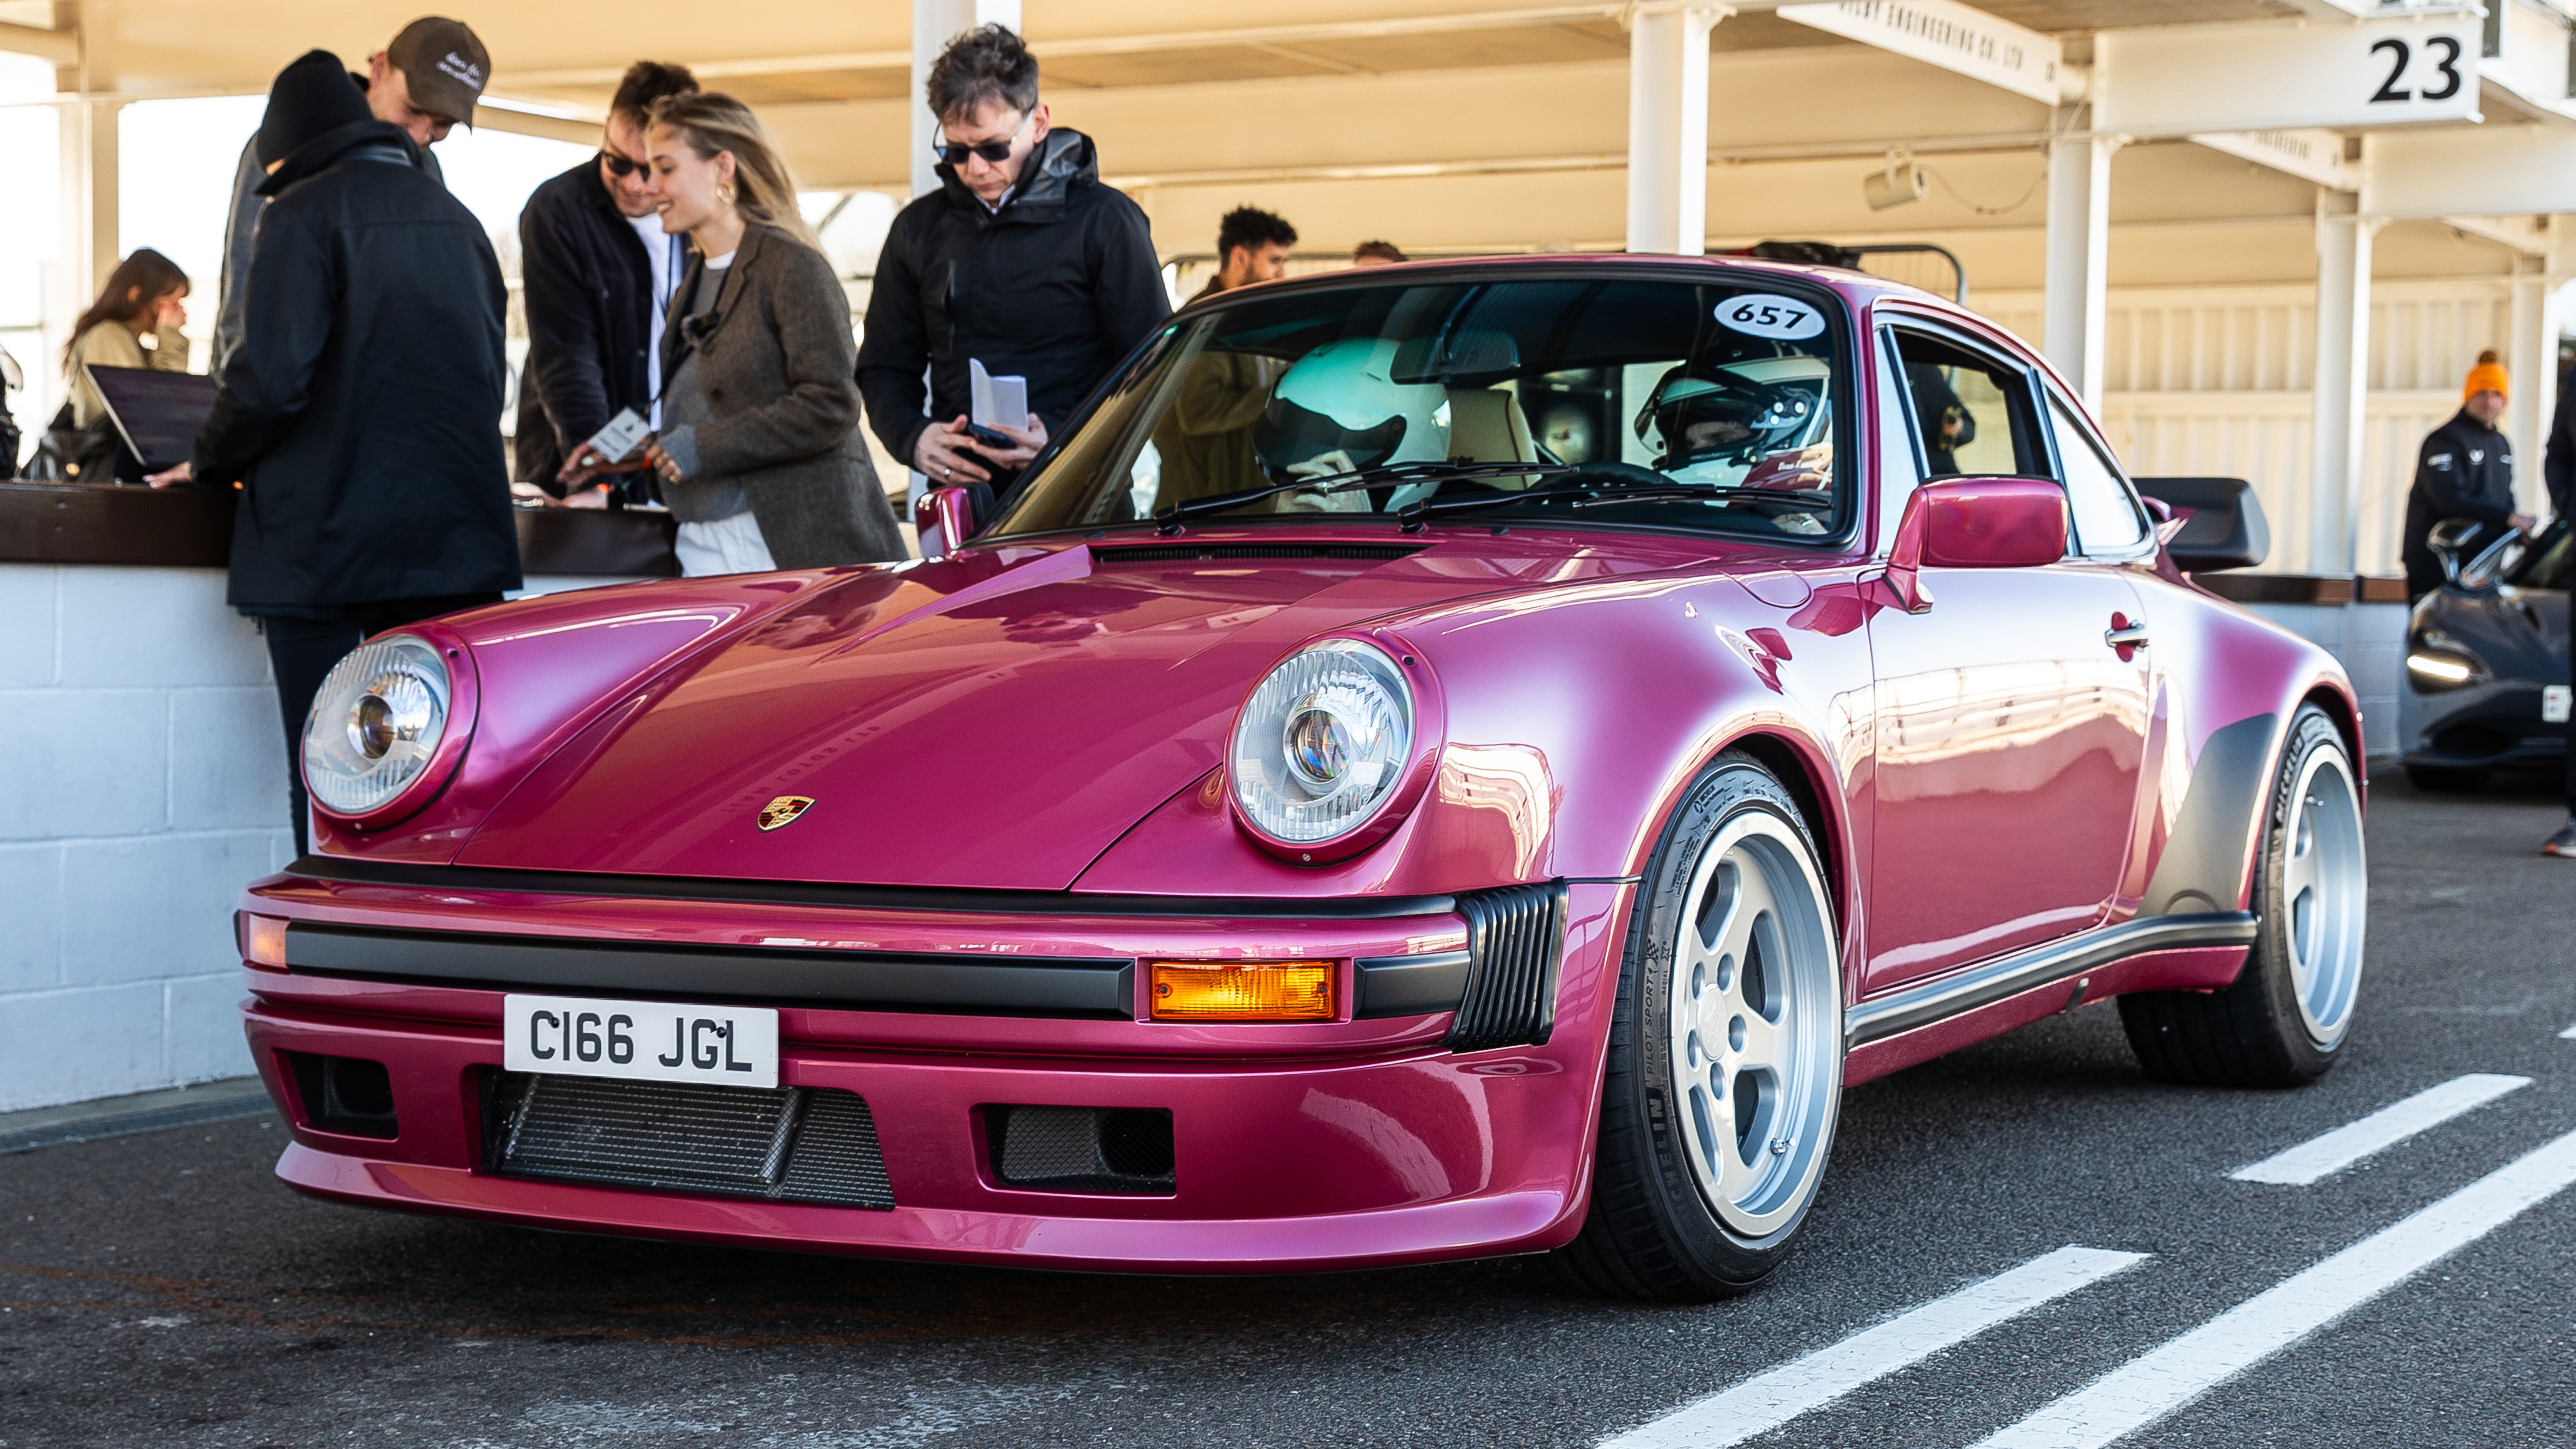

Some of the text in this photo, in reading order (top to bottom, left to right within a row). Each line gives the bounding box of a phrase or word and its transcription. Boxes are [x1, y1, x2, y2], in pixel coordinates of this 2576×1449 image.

[1887, 3, 1975, 53] ENGINEERING
[2370, 37, 2460, 101] 23
[1732, 303, 1808, 329] 657
[1645, 976, 1654, 1027] SPORT
[530, 1010, 753, 1073] C166 JGL
[1645, 1031, 1654, 1075] PILOT
